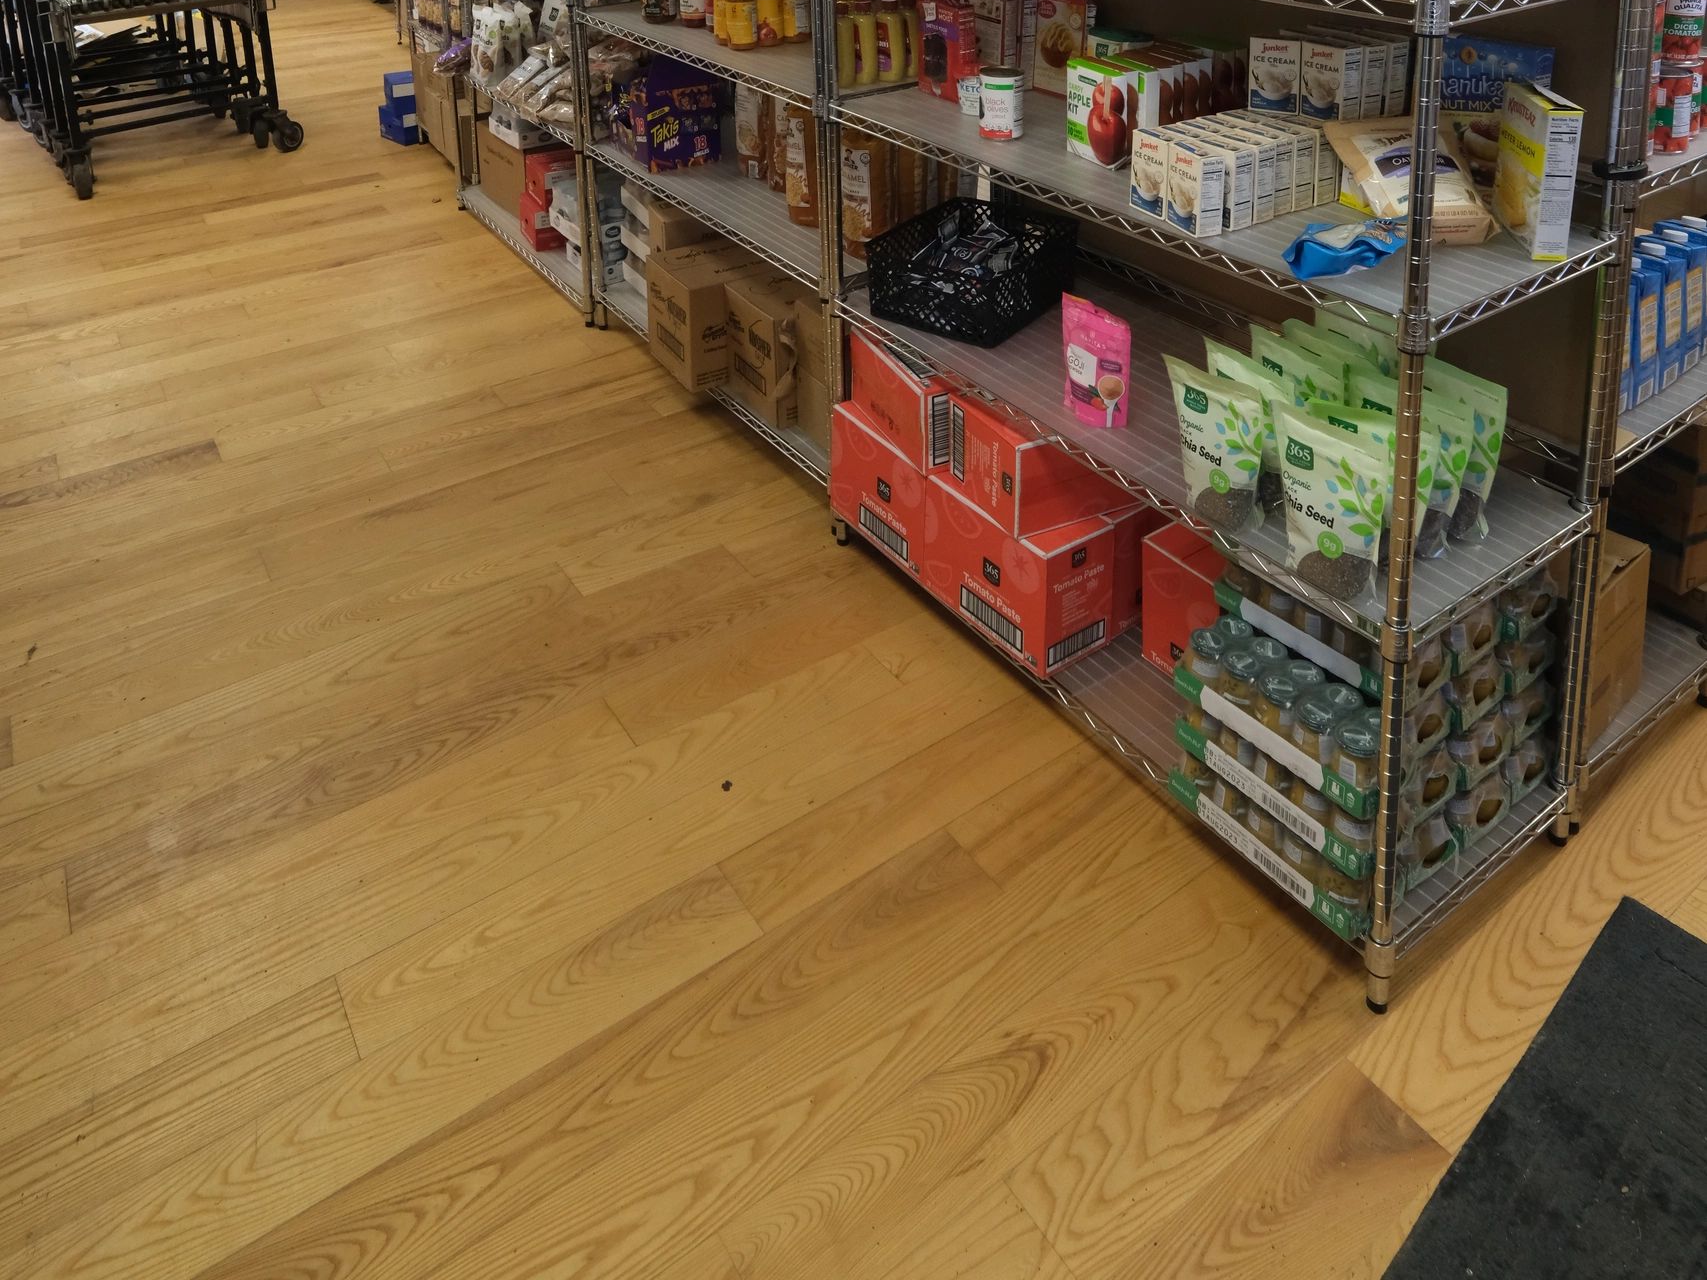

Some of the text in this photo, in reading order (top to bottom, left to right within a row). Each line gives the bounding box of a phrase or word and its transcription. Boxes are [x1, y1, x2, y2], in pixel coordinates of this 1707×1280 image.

[1261, 43, 1288, 53] junket
[1310, 48, 1334, 59] junket
[1267, 56, 1296, 65] CREAM
[1304, 60, 1339, 73] ICE CREAM
[985, 96, 1006, 107] black
[1068, 91, 1091, 108] APPLE
[1440, 99, 1491, 111] NUT MIX
[987, 105, 1009, 114] olives
[1068, 103, 1079, 116] KIT
[651, 119, 679, 148] Takis
[664, 136, 680, 151] MIX
[694, 135, 707, 151] 18
[1139, 138, 1159, 152] junket
[1516, 140, 1536, 159] LEMON
[1143, 154, 1163, 167] CREAM
[1175, 152, 1193, 166] junket
[1170, 164, 1197, 182] ICE CREAM
[1068, 356, 1085, 370] GOJI
[1187, 390, 1206, 406] 365
[1180, 414, 1204, 433] Organic
[1198, 446, 1222, 467] Seed
[1287, 442, 1311, 462] 365
[1283, 470, 1311, 491] Organic
[879, 481, 890, 497] 365
[861, 491, 908, 536] Tomato Paste
[1305, 505, 1334, 530] Seed
[1323, 538, 1336, 552] 9g
[985, 562, 999, 580] 365
[1053, 563, 1105, 594] Tomato Paste
[963, 571, 1021, 624] Tomato Paste
[1150, 650, 1174, 673] Toma
